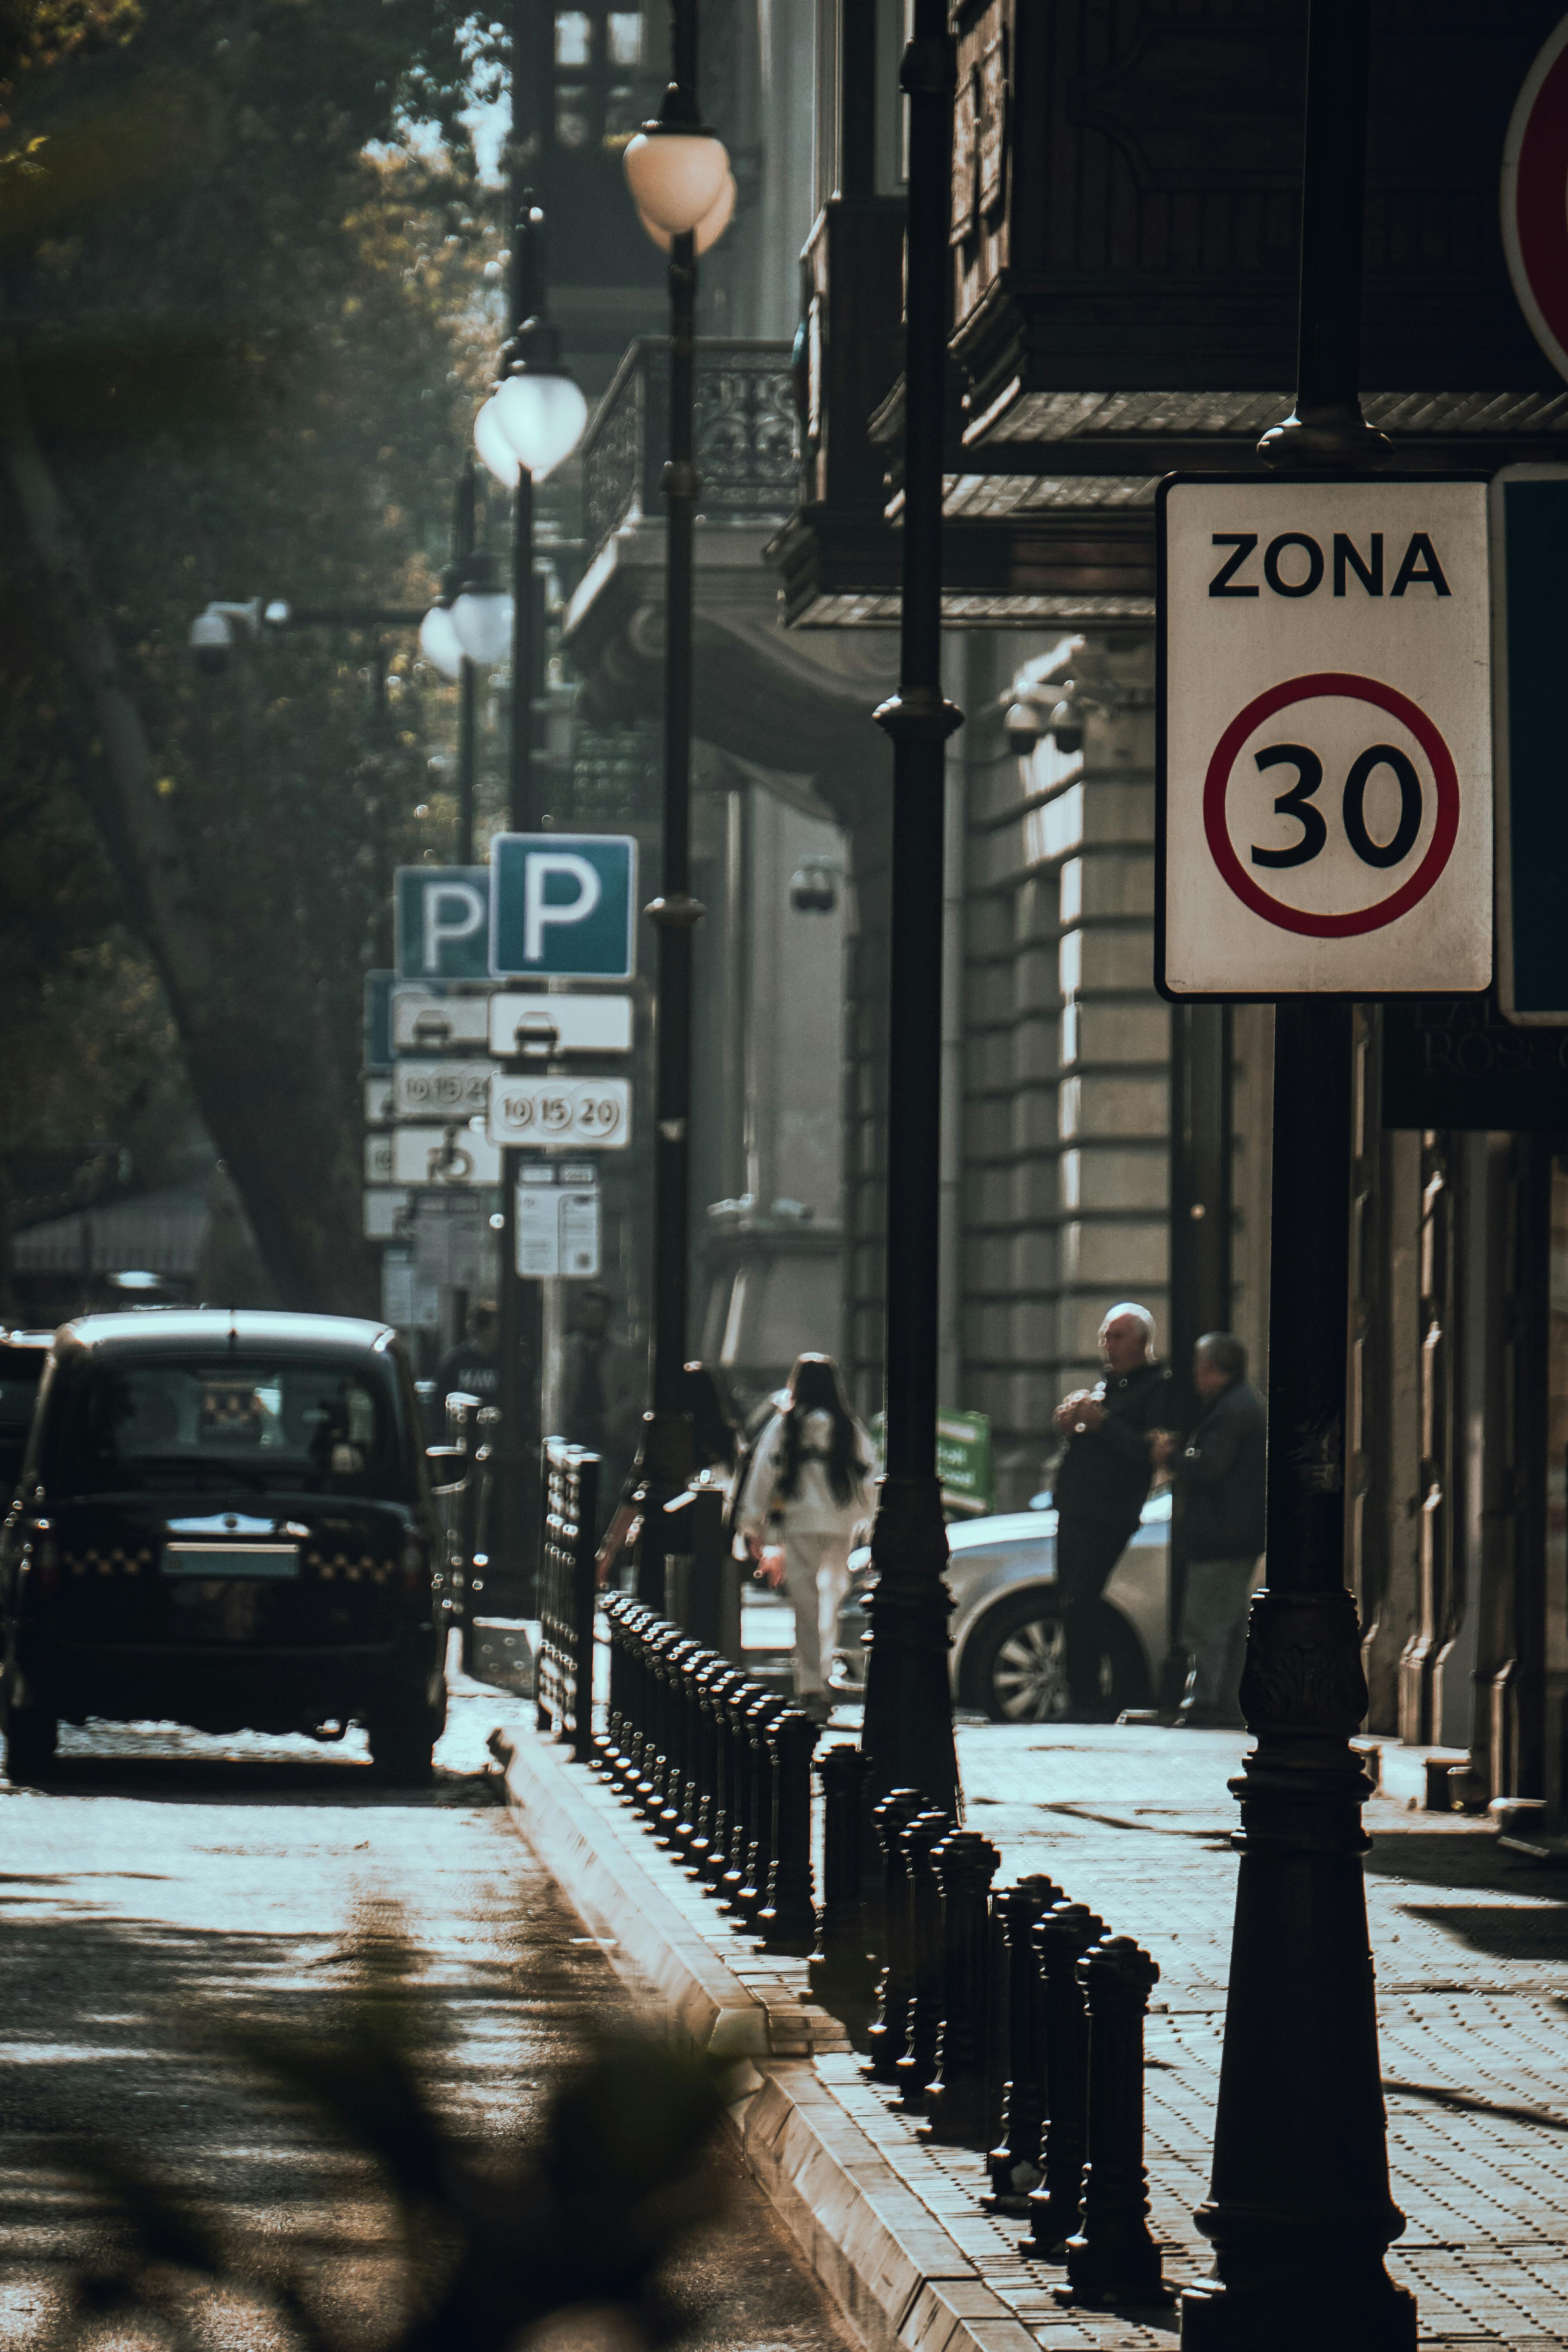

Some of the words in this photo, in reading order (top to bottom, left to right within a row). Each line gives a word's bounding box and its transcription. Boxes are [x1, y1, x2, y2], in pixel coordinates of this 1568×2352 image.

[1209, 532, 1453, 598] ZONA
[1251, 742, 1423, 868] 30
[422, 881, 485, 972] P
[524, 852, 601, 963] P
[1424, 1031, 1568, 1076] ROSS
[503, 1097, 528, 1118] 10
[540, 1098, 565, 1121] 15
[579, 1098, 614, 1126] 20
